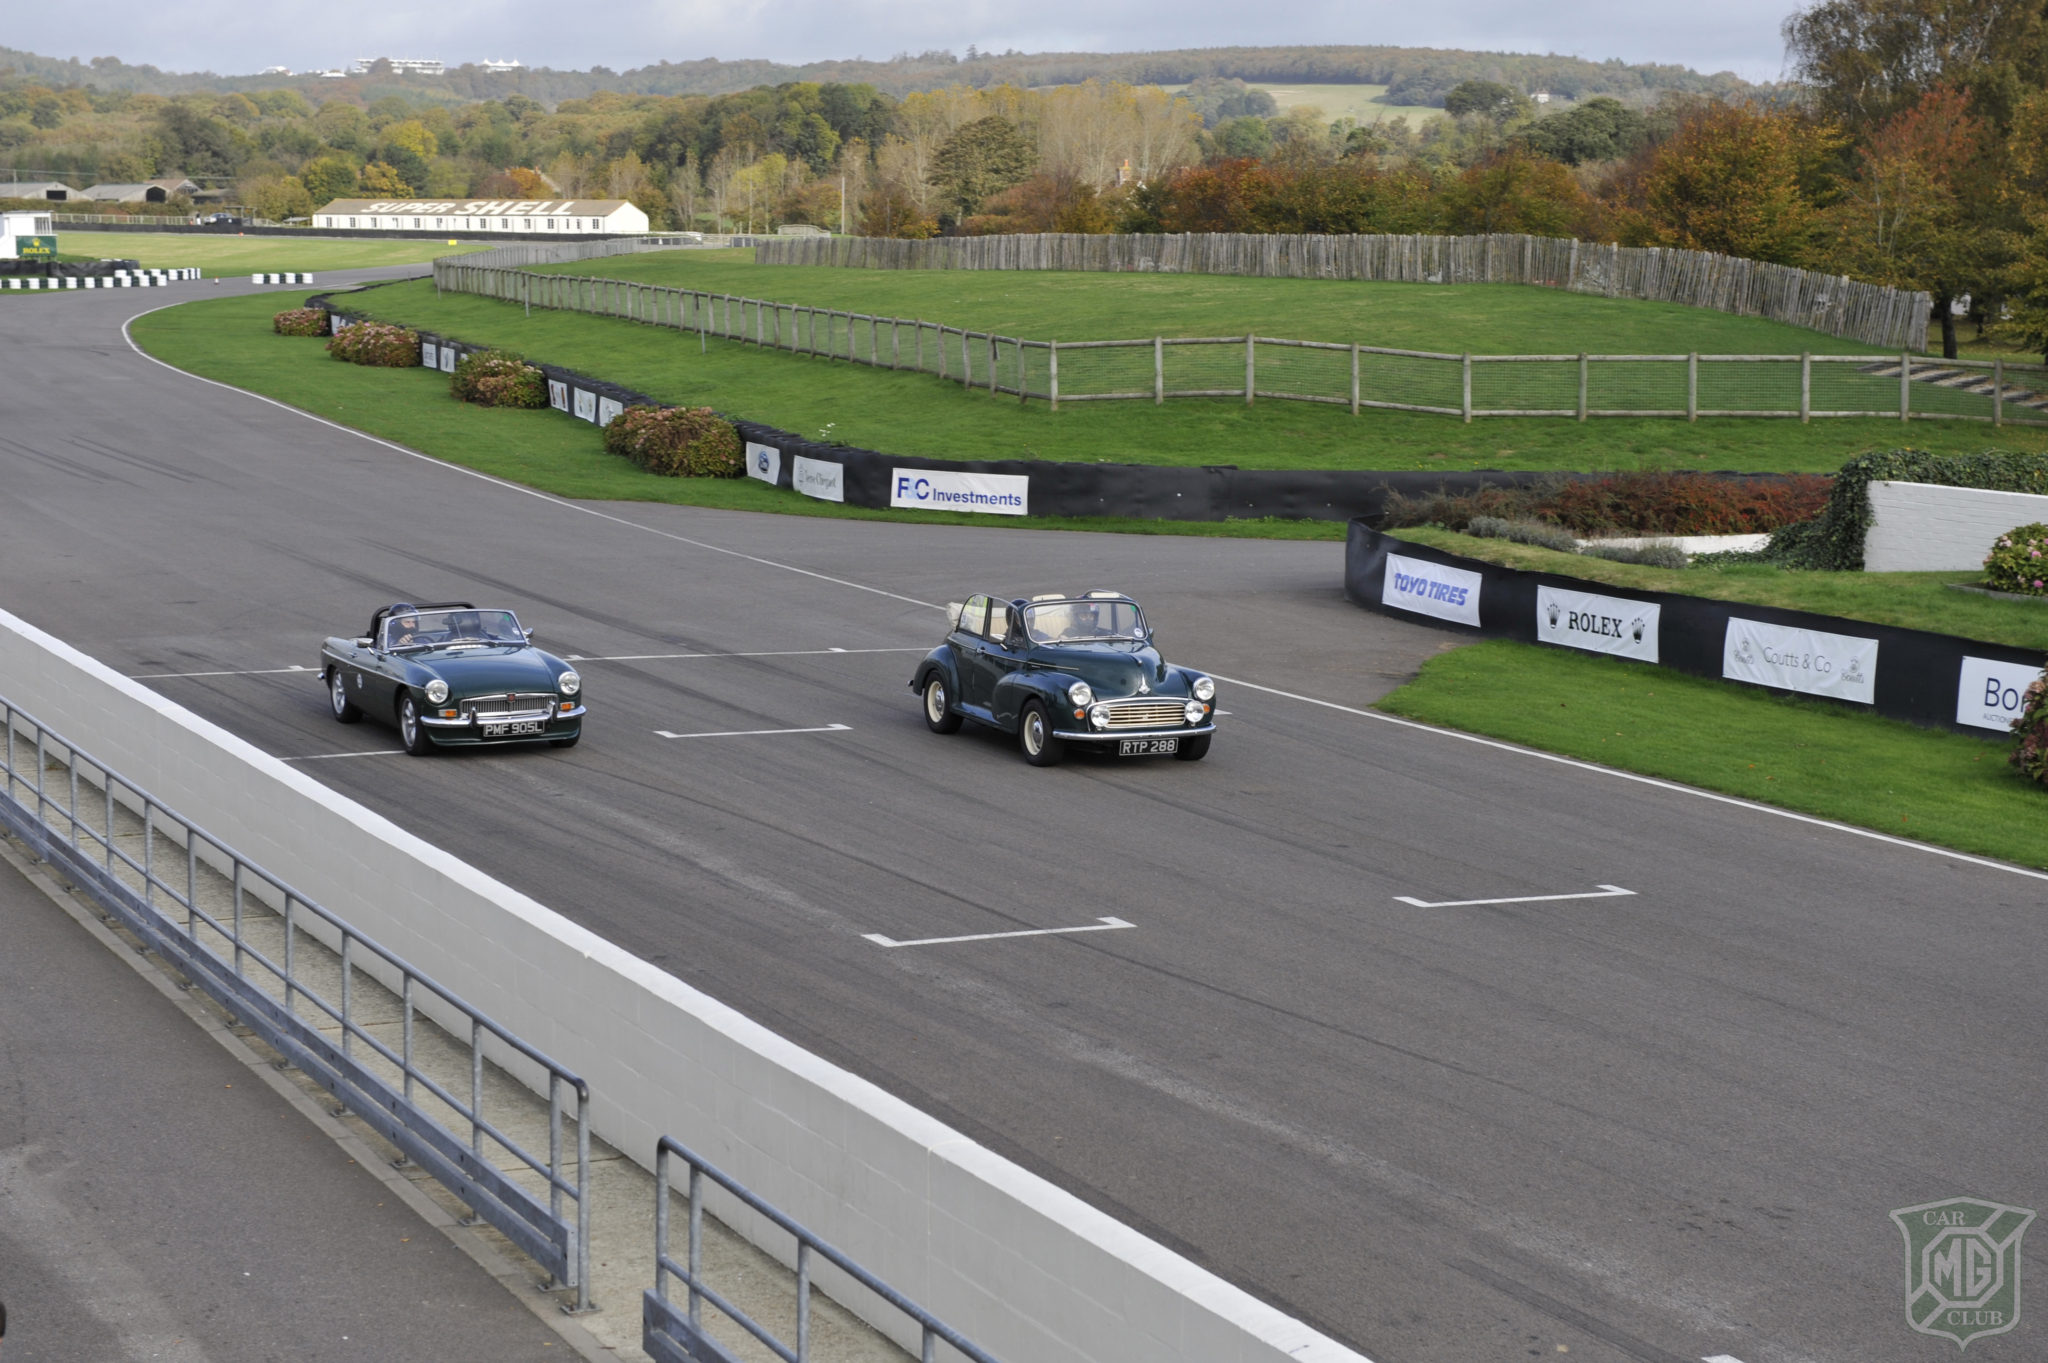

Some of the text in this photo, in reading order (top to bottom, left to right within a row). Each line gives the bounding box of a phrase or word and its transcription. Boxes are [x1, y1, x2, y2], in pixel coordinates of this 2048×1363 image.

[361, 201, 575, 215] SUPER SHELL
[897, 477, 1022, 506] F&C Investments
[1393, 573, 1468, 606] TOYO TIRES
[1568, 610, 1623, 639] ROLEX
[1763, 646, 1799, 668] Coutts
[1801, 653, 1811, 670] &
[1814, 655, 1832, 673] Co
[486, 723, 541, 735] PMF 905L
[1122, 739, 1175, 754] RTP 288
